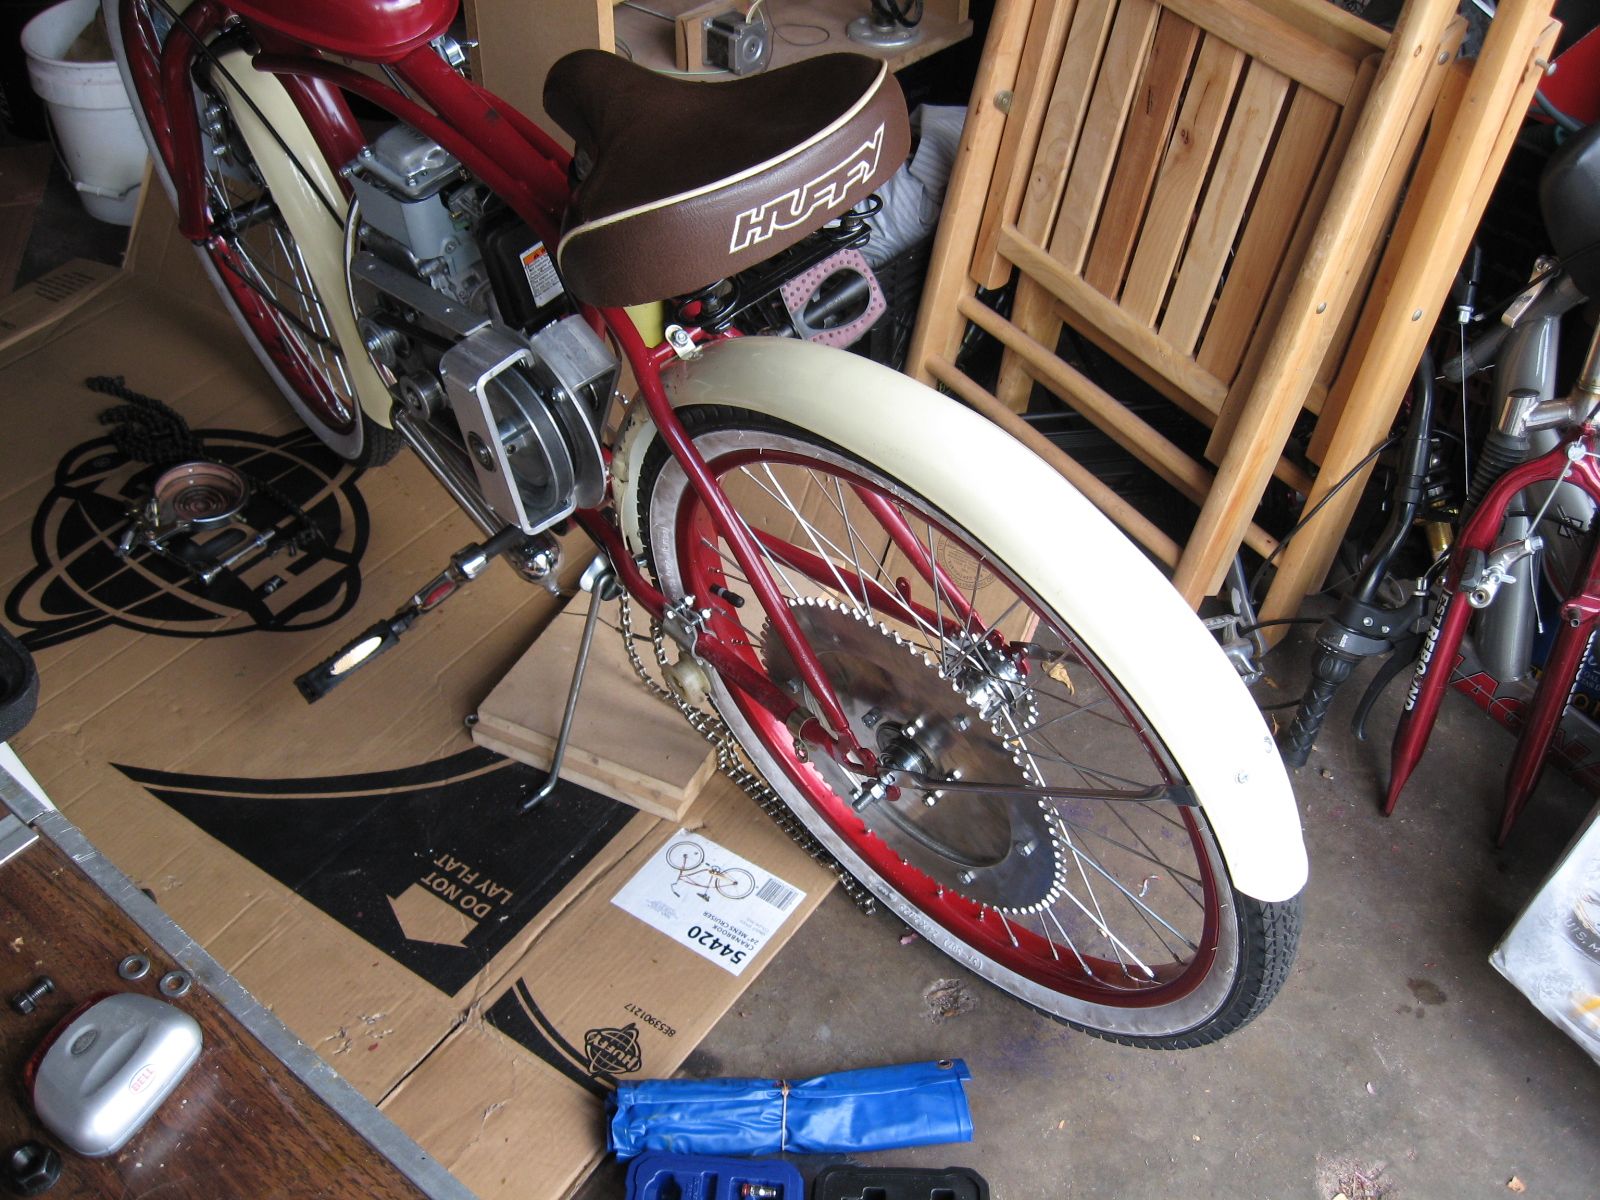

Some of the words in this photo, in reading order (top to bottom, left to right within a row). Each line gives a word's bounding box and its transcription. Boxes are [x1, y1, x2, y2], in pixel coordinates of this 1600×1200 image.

[729, 122, 886, 254] HUFFY
[433, 853, 480, 884] FLAT
[420, 872, 463, 900] NOT
[474, 879, 513, 905] LAY
[460, 895, 492, 919] DO
[703, 912, 729, 926] CRUISER
[688, 926, 747, 964] 54420
[713, 925, 754, 951] CRANBROOK
[728, 925, 748, 938] MENS
[624, 1003, 677, 1037] 8E53901217
[592, 1033, 640, 1069] HUFFY
[131, 1067, 155, 1092] BELL
